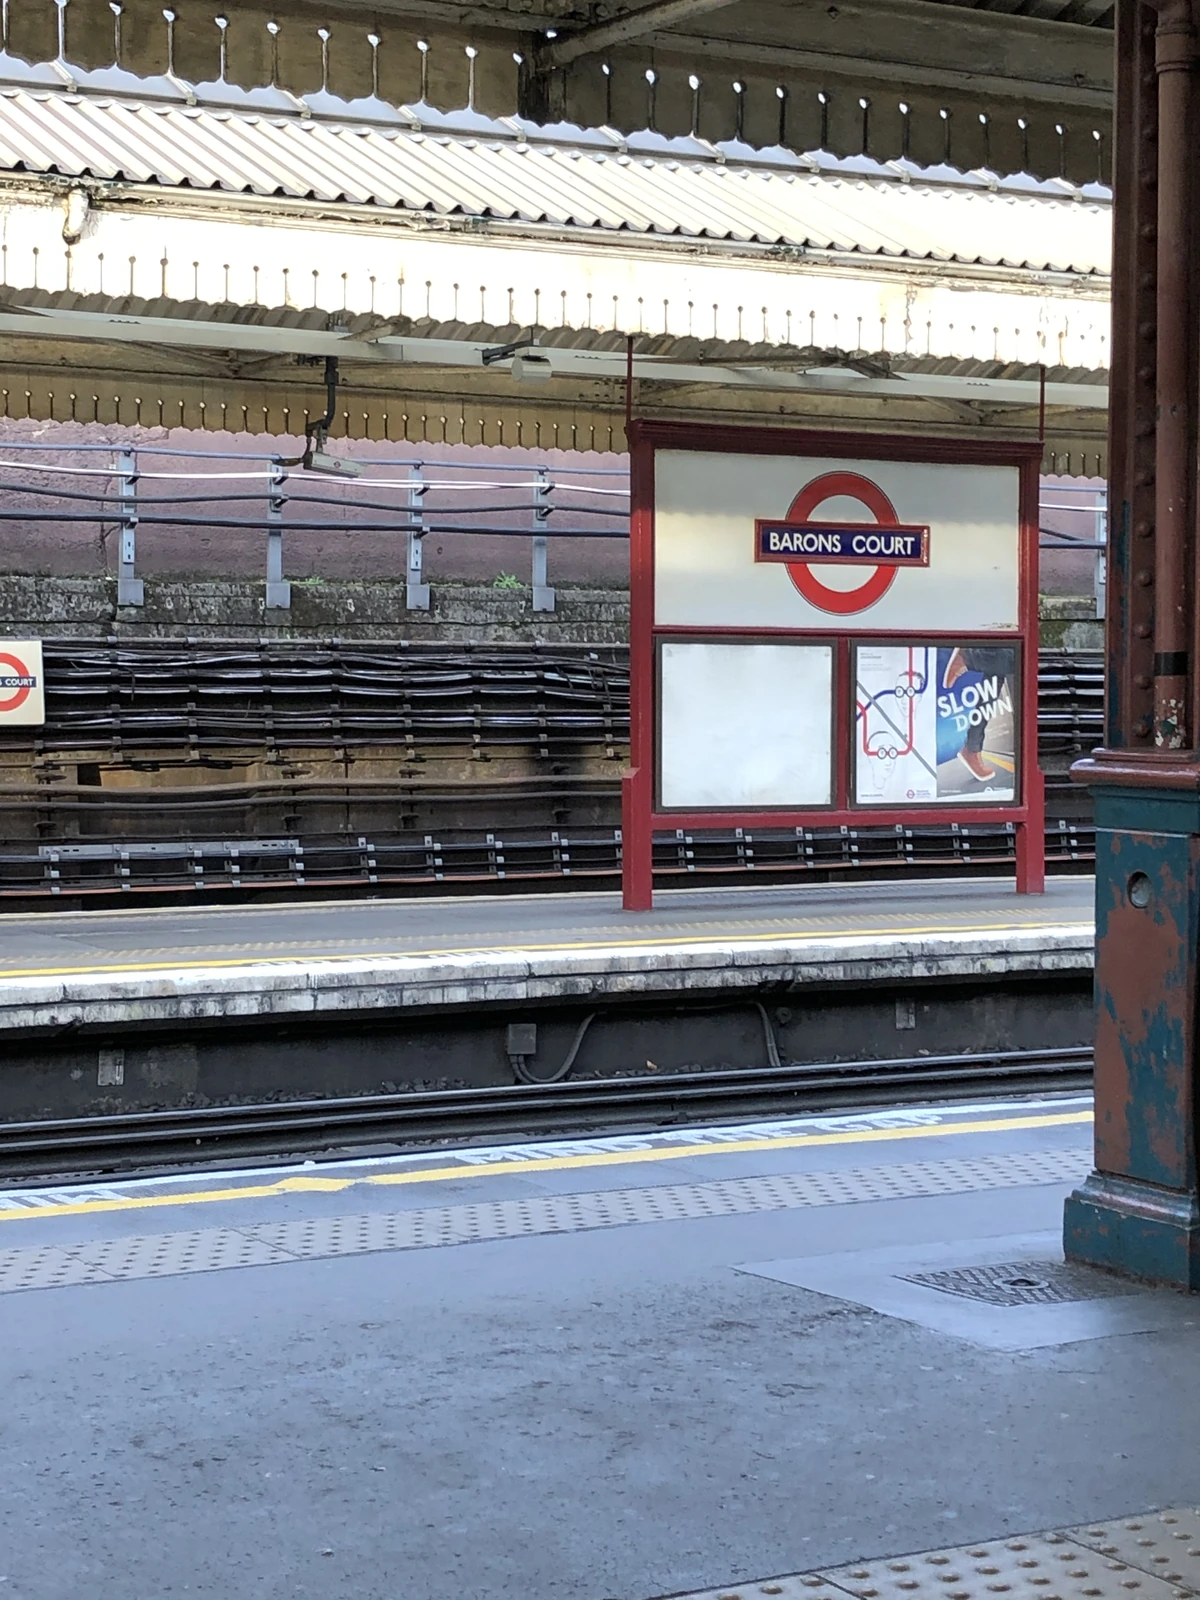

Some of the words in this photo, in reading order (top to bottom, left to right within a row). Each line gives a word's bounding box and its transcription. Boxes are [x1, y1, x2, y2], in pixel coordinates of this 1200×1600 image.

[769, 532, 841, 553] BARONS
[852, 535, 915, 555] COURT
[5, 678, 34, 686] COURT
[937, 675, 998, 718] SLOW
[952, 696, 1013, 732] DOWN
[454, 1136, 652, 1165] MIND
[663, 1121, 807, 1144] THE
[817, 1111, 942, 1132] GAP
